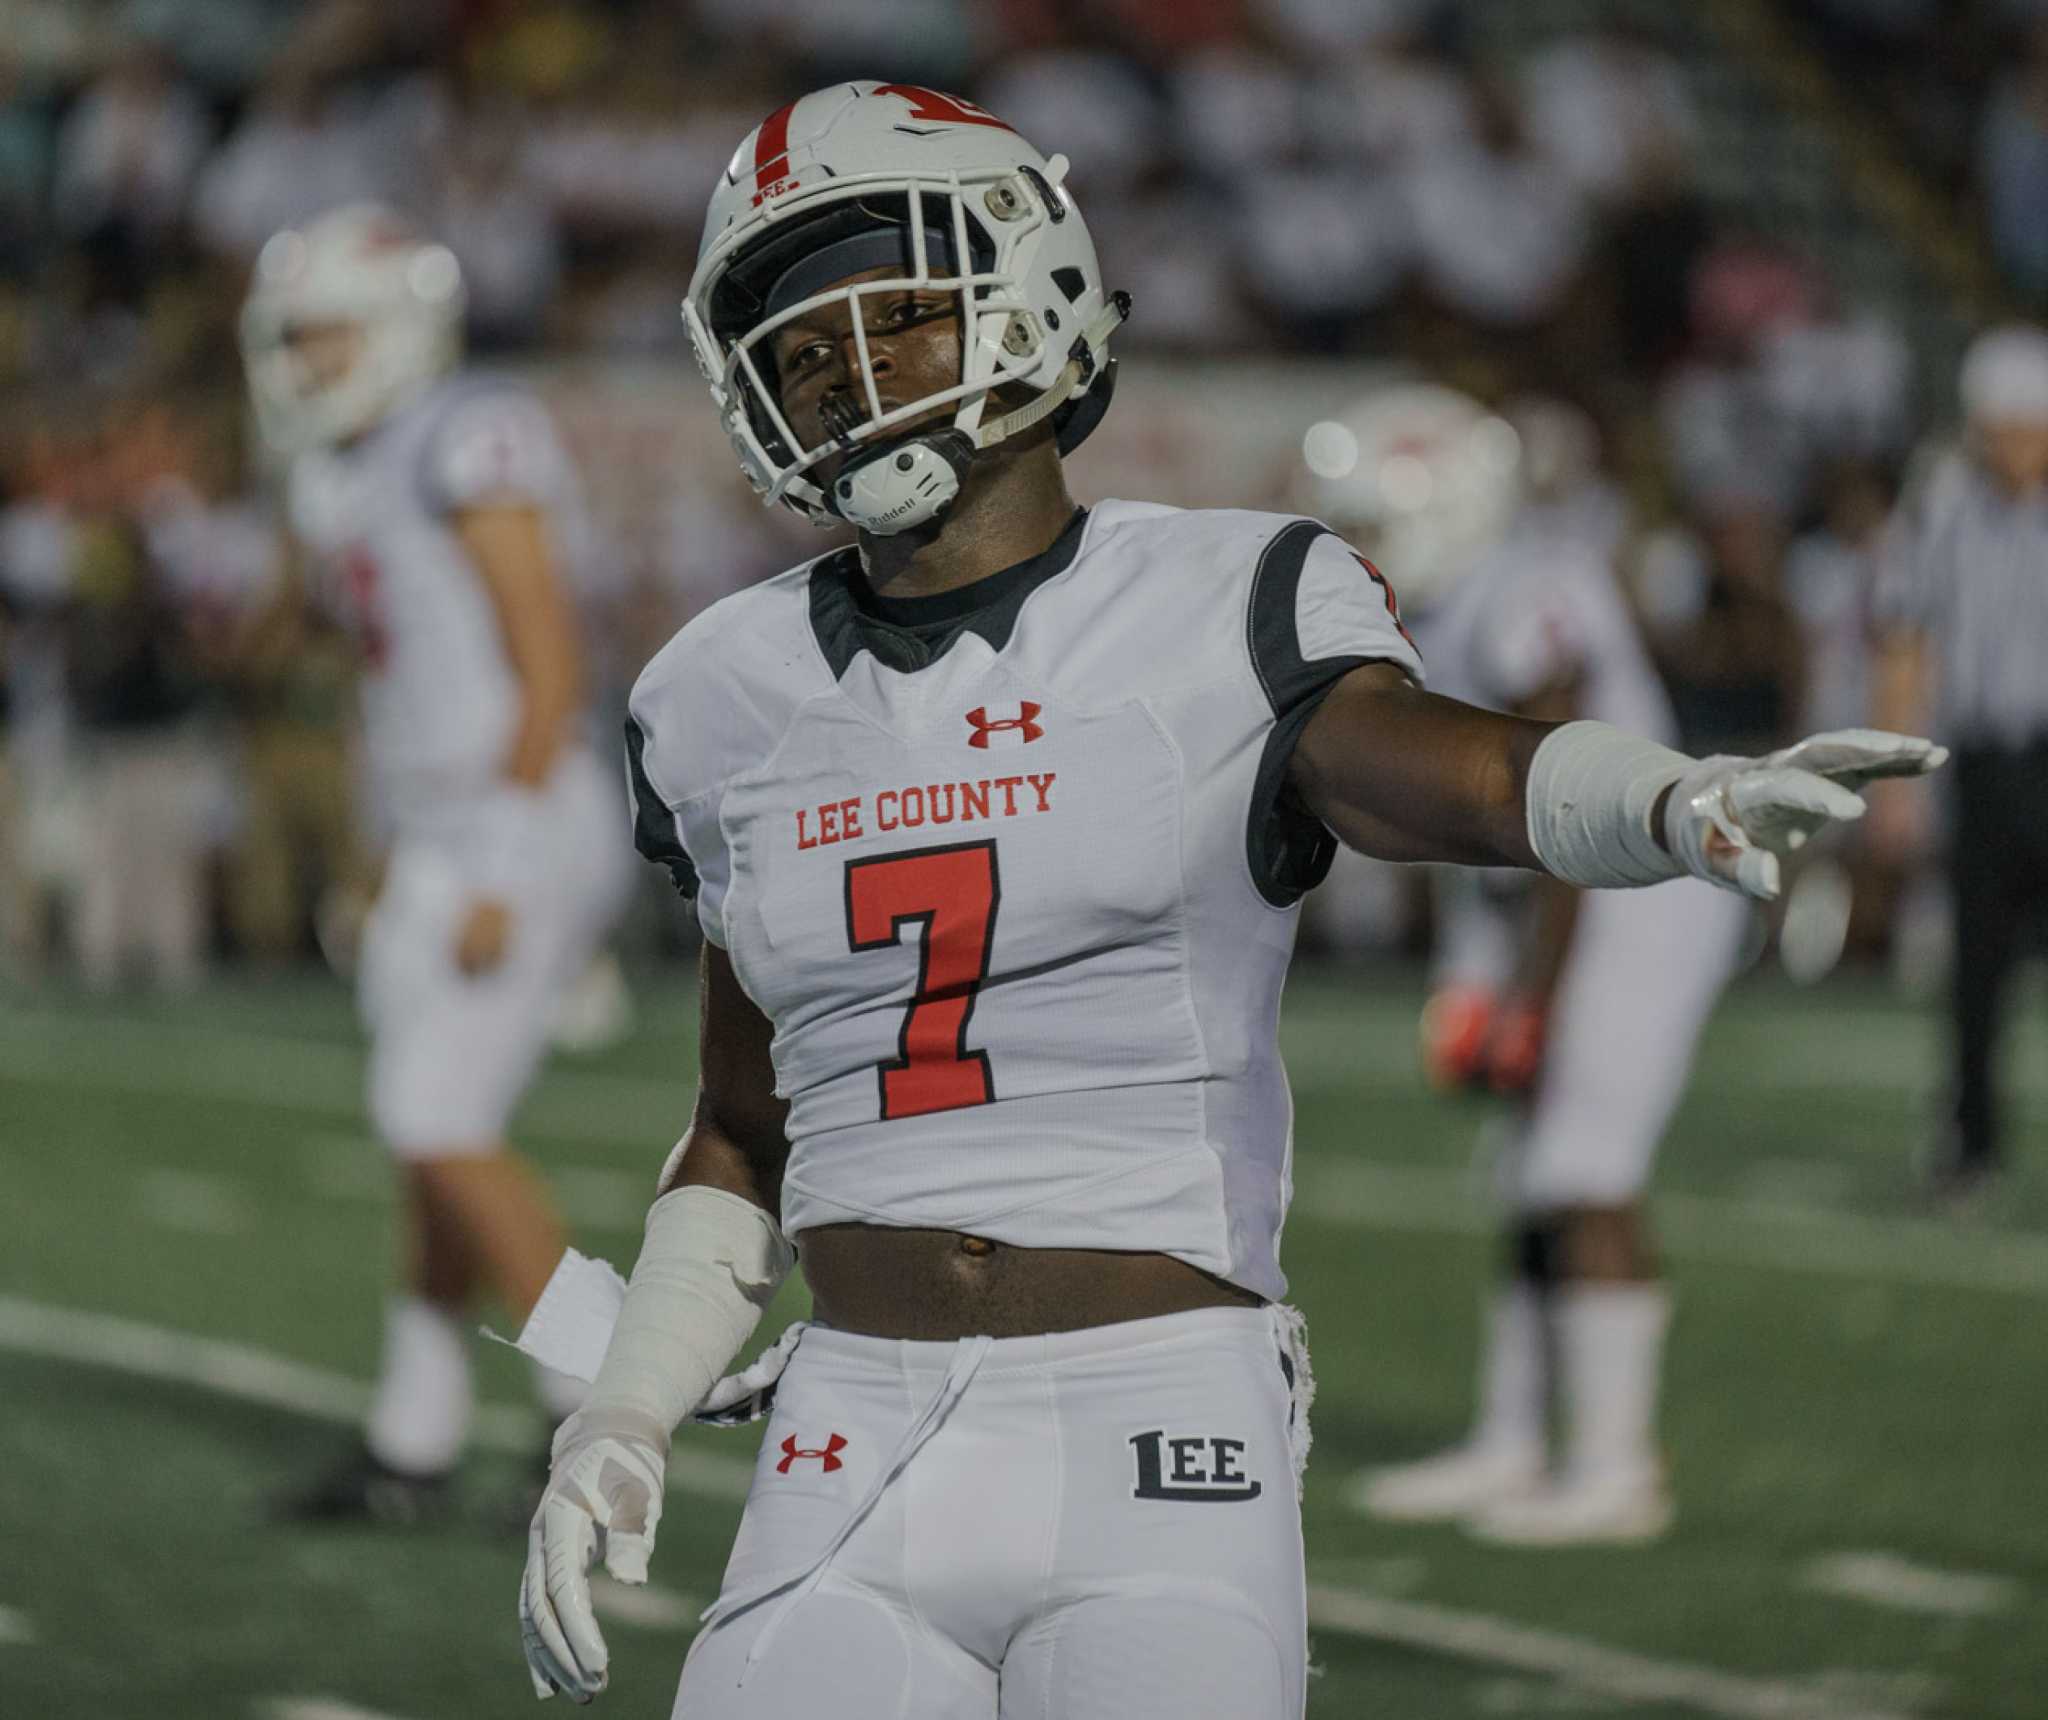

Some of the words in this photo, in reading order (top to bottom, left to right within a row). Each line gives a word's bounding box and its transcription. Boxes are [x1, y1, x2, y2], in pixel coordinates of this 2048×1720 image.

[796, 797, 863, 850] LEE
[876, 773, 1056, 831] COUNTY
[844, 838, 1001, 1121] 7
[1129, 1430, 1261, 1503] LEE
